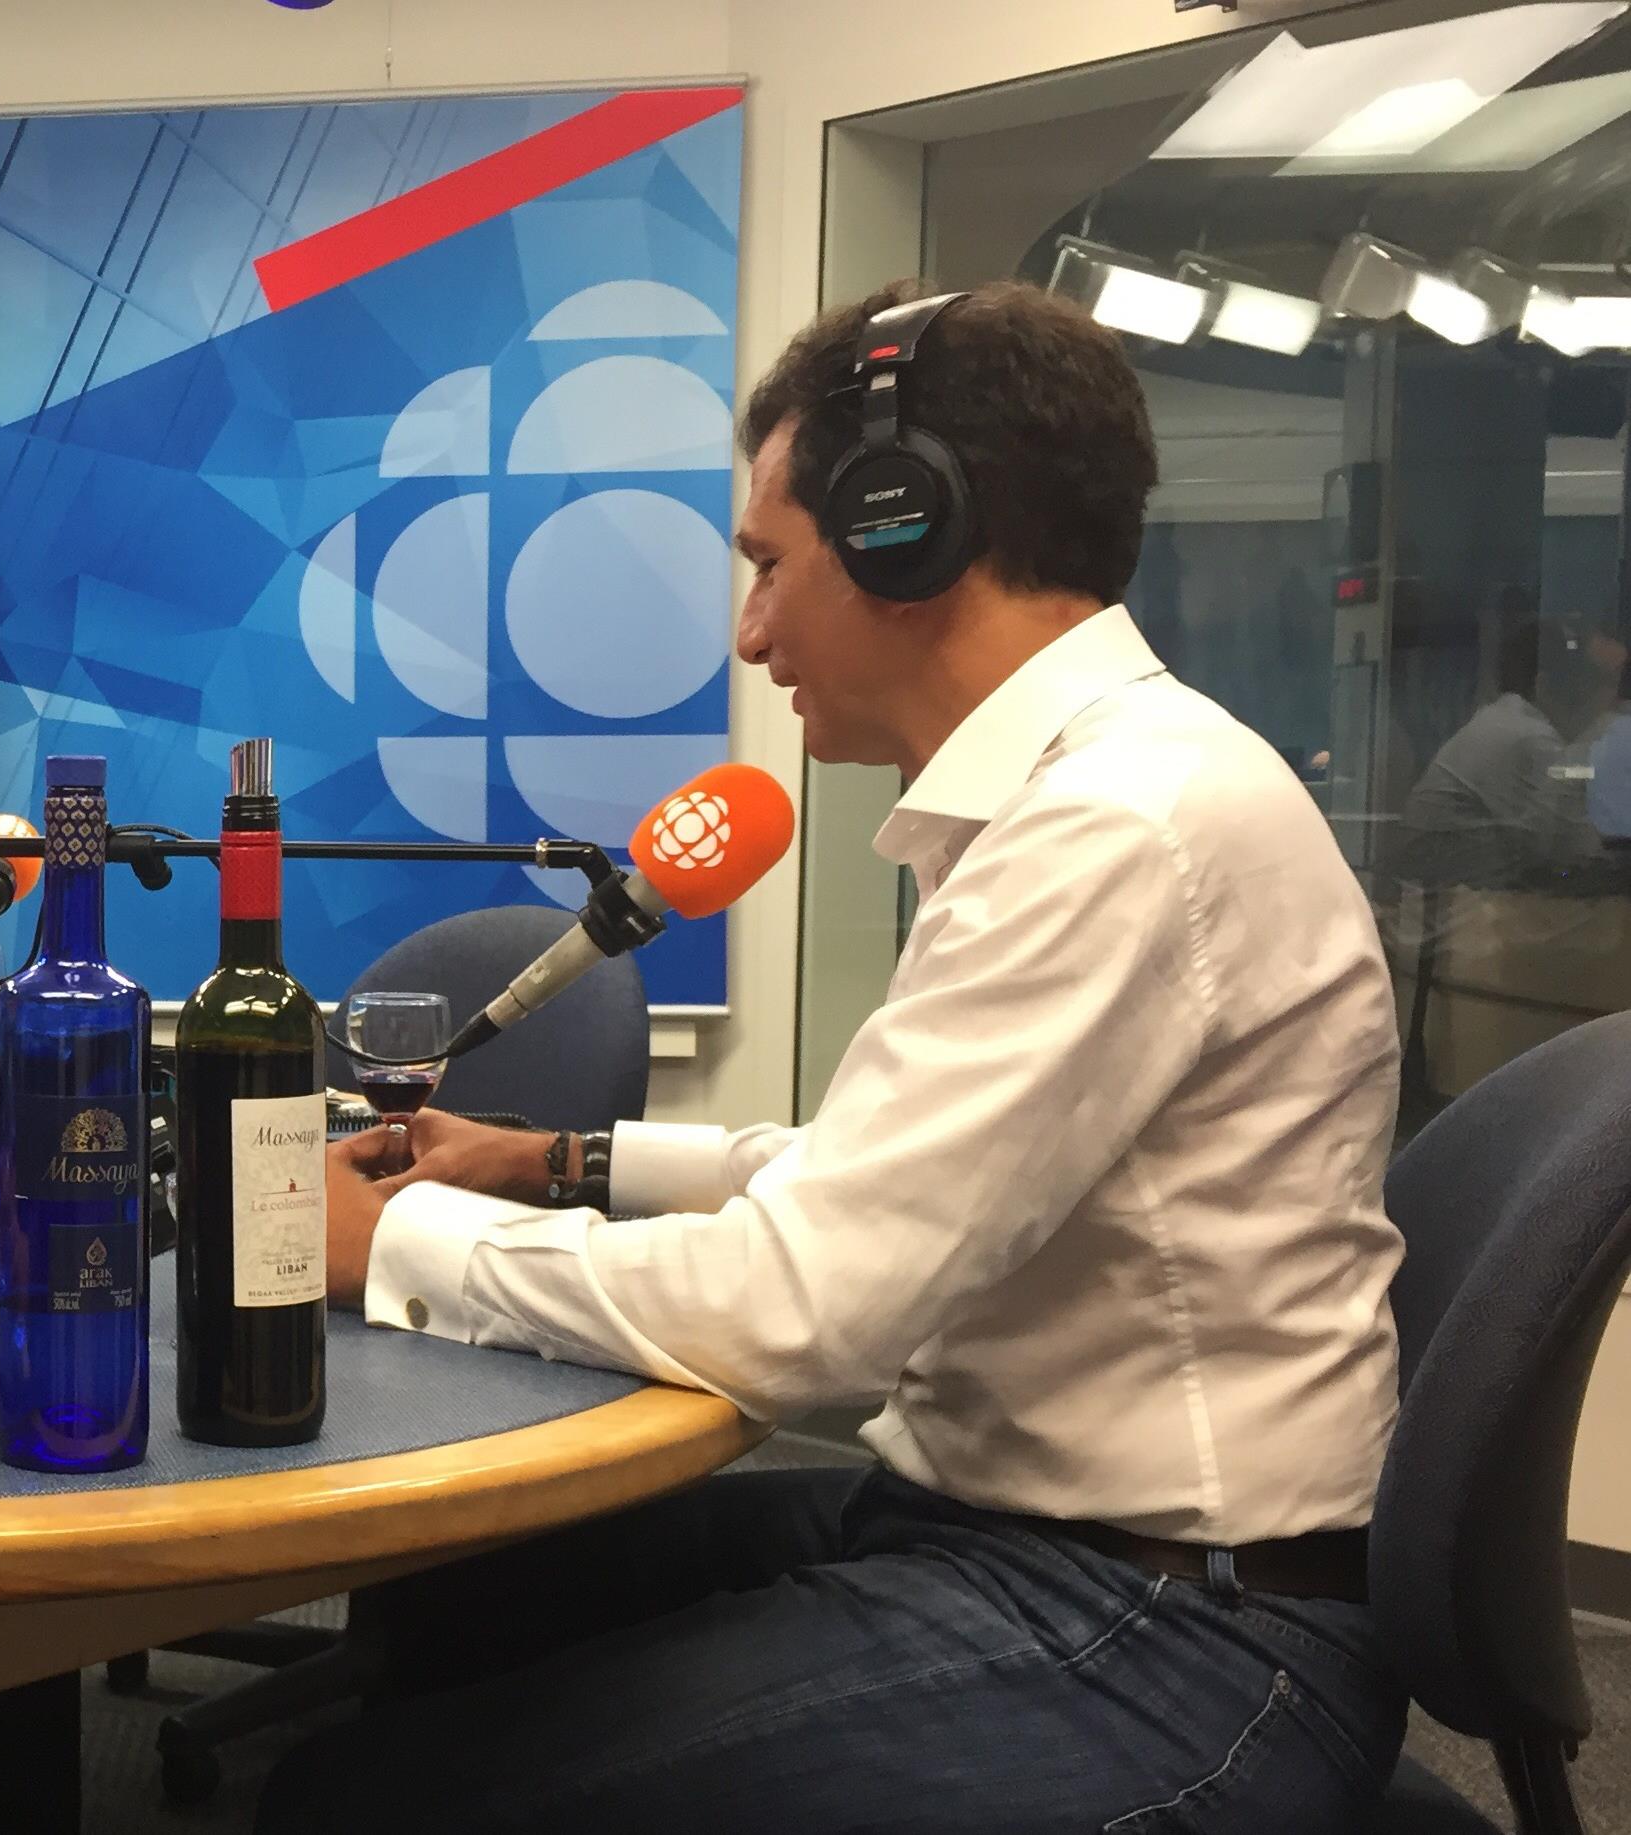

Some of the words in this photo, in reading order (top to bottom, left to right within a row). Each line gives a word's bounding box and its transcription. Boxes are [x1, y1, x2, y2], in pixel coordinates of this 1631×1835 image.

[864, 486, 907, 504] SONY
[42, 1157, 139, 1195] Massaya
[276, 1263, 308, 1275] LIBAN
